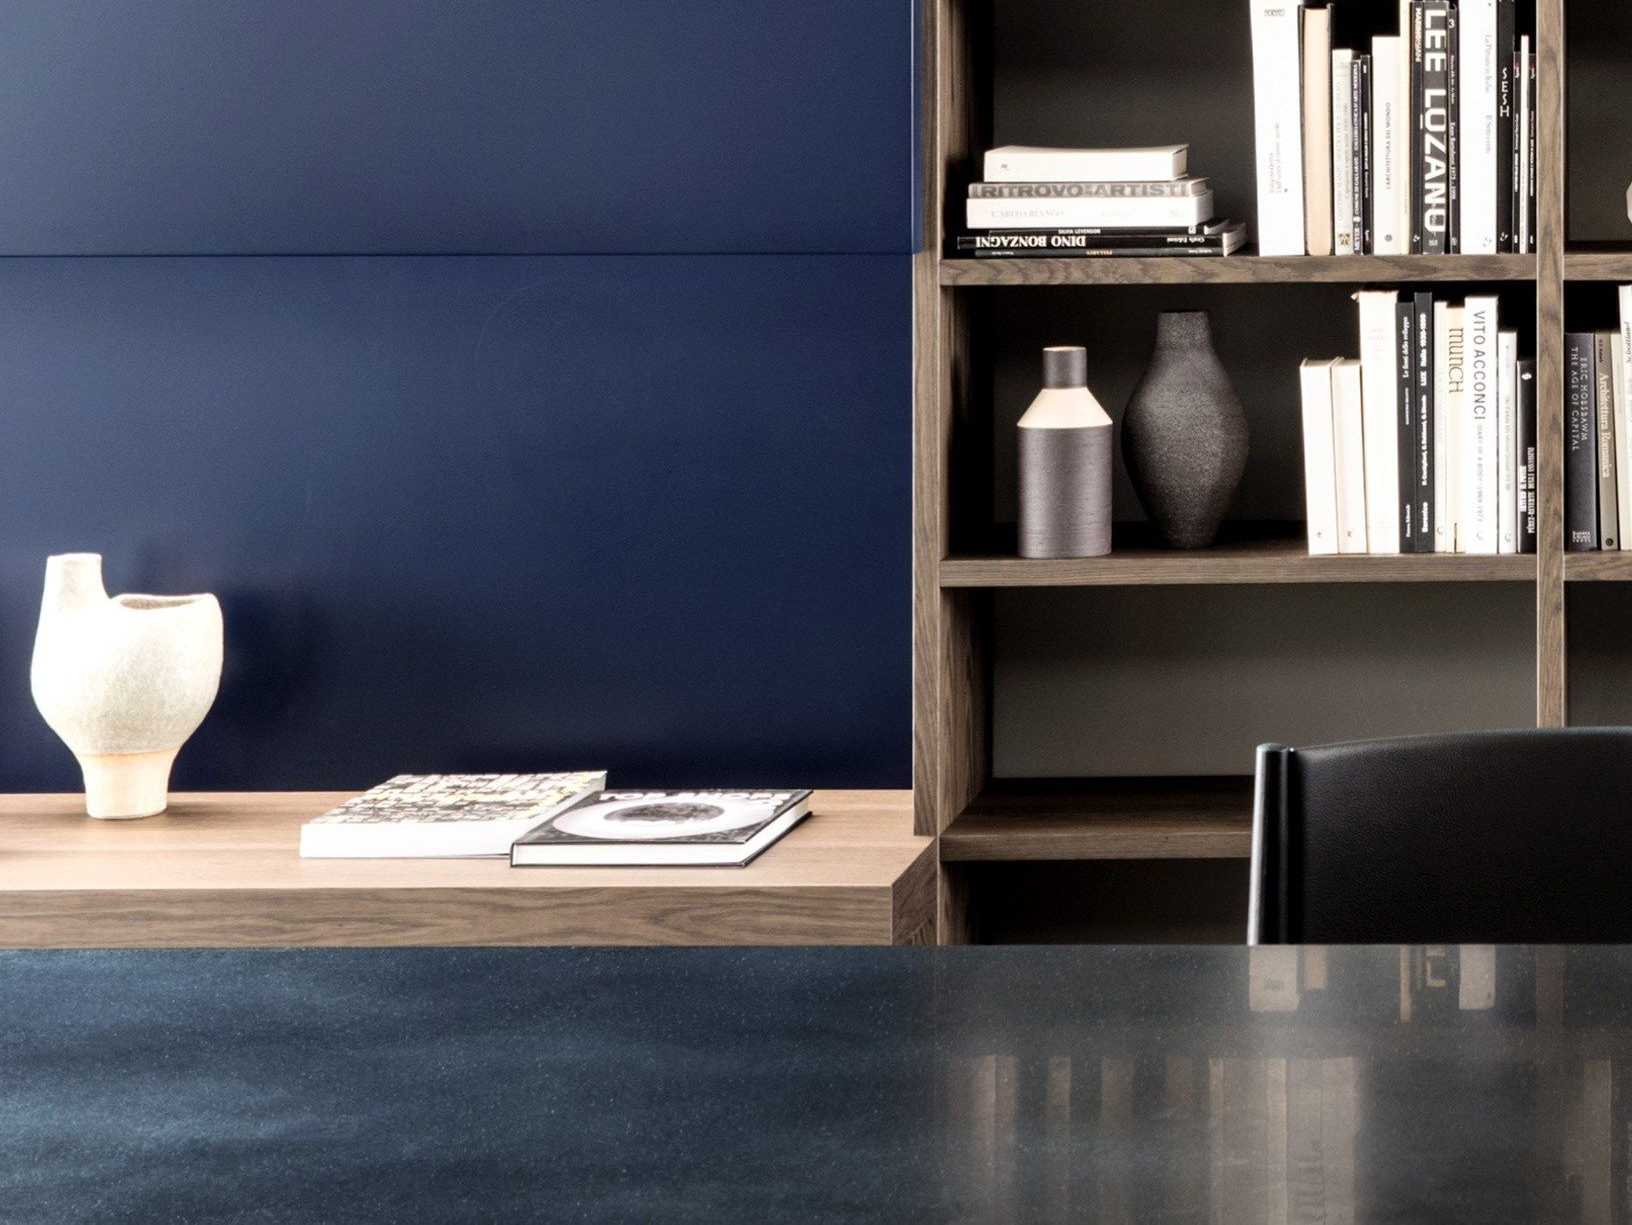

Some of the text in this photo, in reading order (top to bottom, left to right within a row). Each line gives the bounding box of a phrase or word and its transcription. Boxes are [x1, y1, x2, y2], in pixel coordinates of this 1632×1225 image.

[1424, 10, 1446, 232] LEE LOZANO
[980, 184, 1187, 197] RITROVO ARTISTI
[976, 237, 1086, 247] DINO BONZAGNI
[1474, 311, 1485, 419] VITO ACCONCI
[1572, 394, 1579, 405] OF
[1599, 373, 1611, 477] Architettura Romanica
